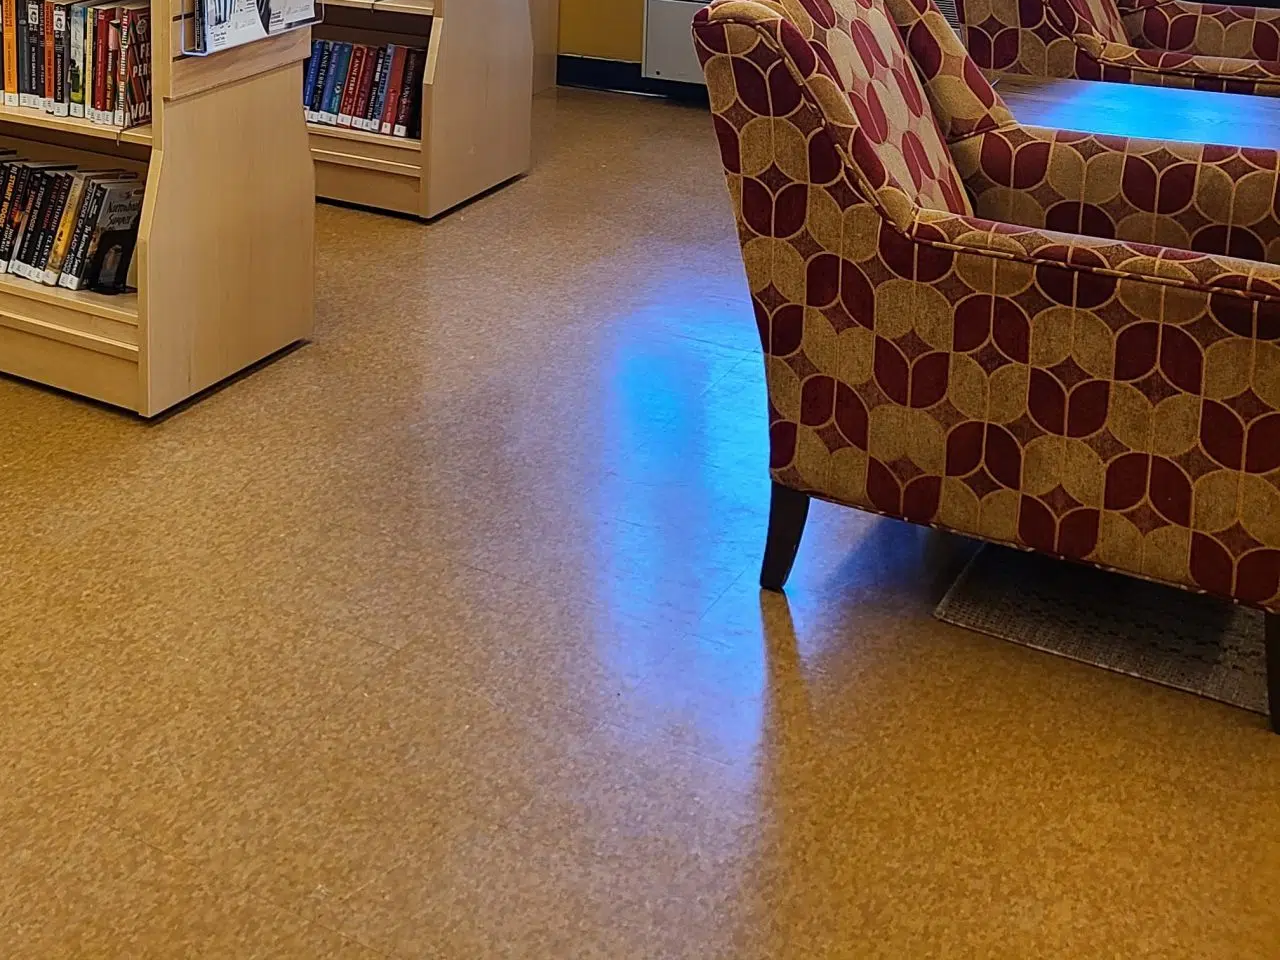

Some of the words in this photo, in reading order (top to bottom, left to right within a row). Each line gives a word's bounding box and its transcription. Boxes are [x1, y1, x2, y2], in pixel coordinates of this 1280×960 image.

[5, 175, 16, 200] STUART
[35, 187, 45, 208] STUART
[59, 178, 69, 204] STUART
[28, 209, 39, 232] WOODS
[51, 205, 63, 231] WOODS
[43, 234, 53, 255] CLASS
[70, 234, 79, 252] LADY
